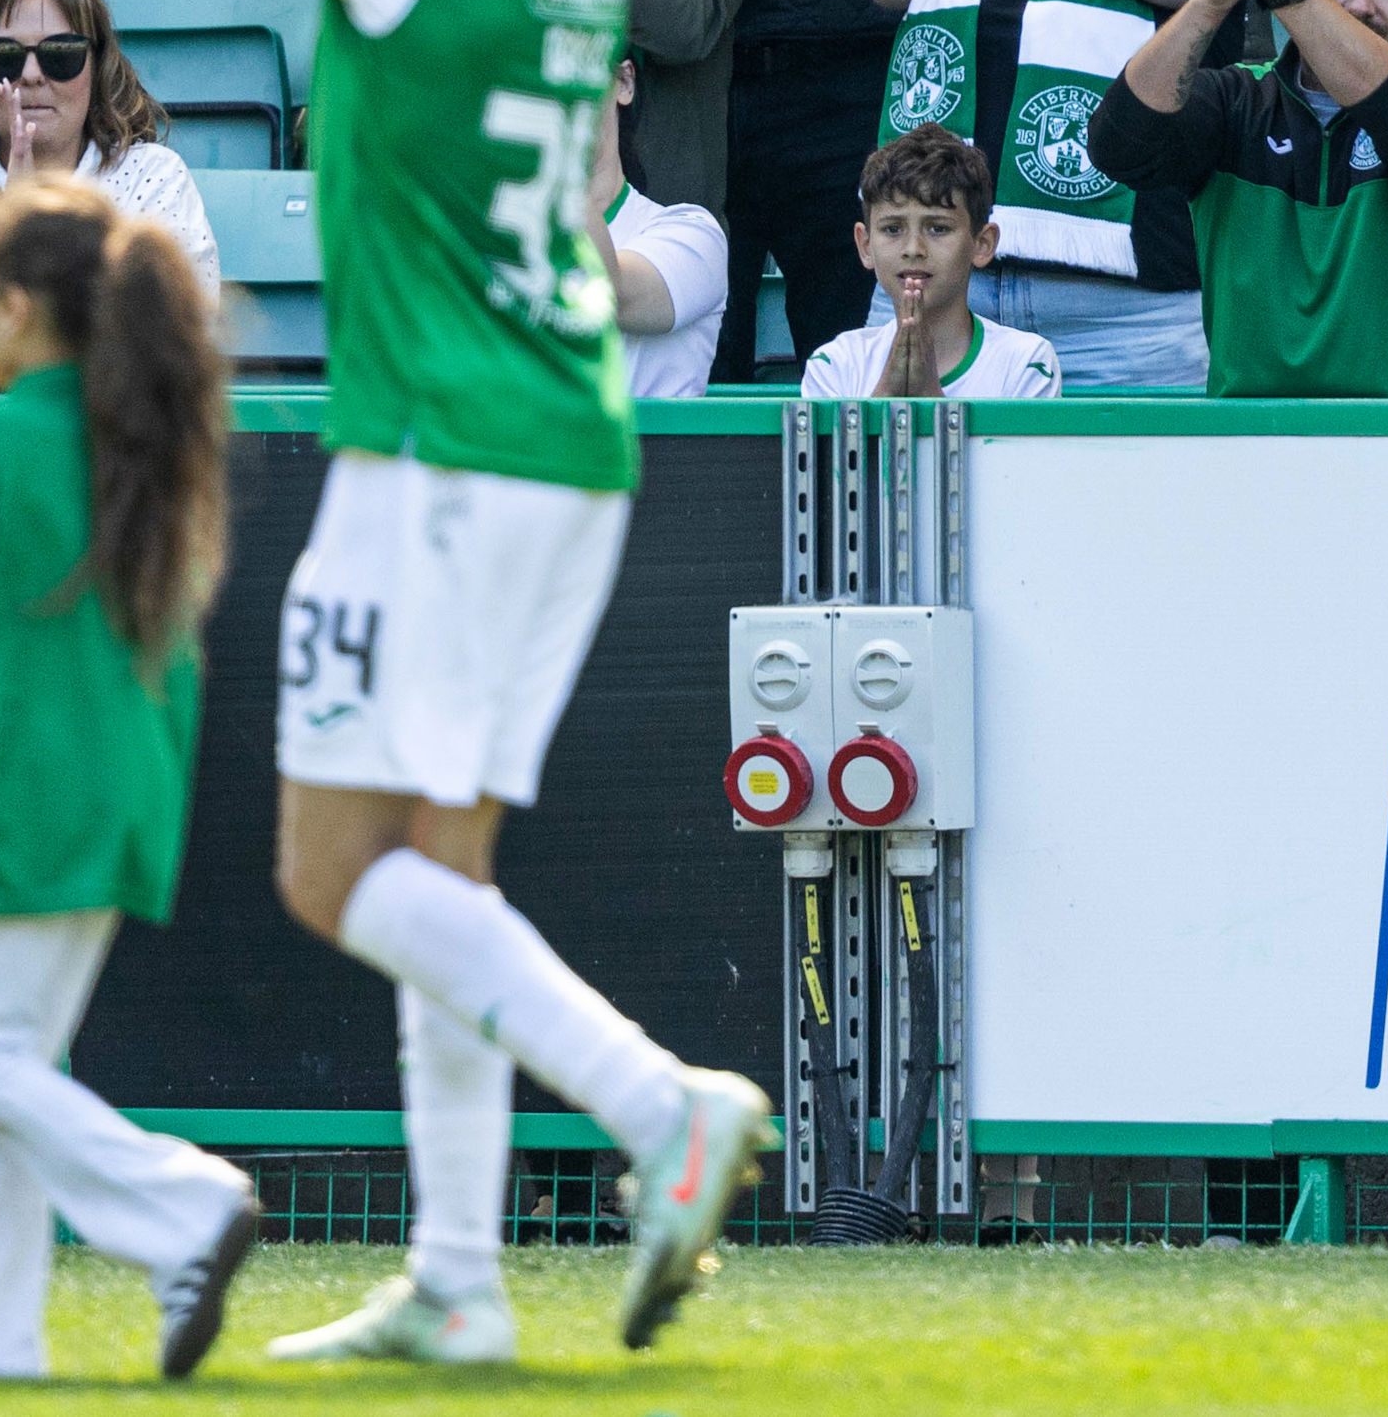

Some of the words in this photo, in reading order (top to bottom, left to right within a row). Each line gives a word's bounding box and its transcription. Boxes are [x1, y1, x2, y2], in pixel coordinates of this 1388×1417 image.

[895, 28, 959, 65] HIBERNIAN
[1029, 87, 1103, 115] HIBERNI
[1015, 129, 1037, 145] 18
[1023, 158, 1111, 195] EDINBURGH
[278, 598, 380, 696] 34
